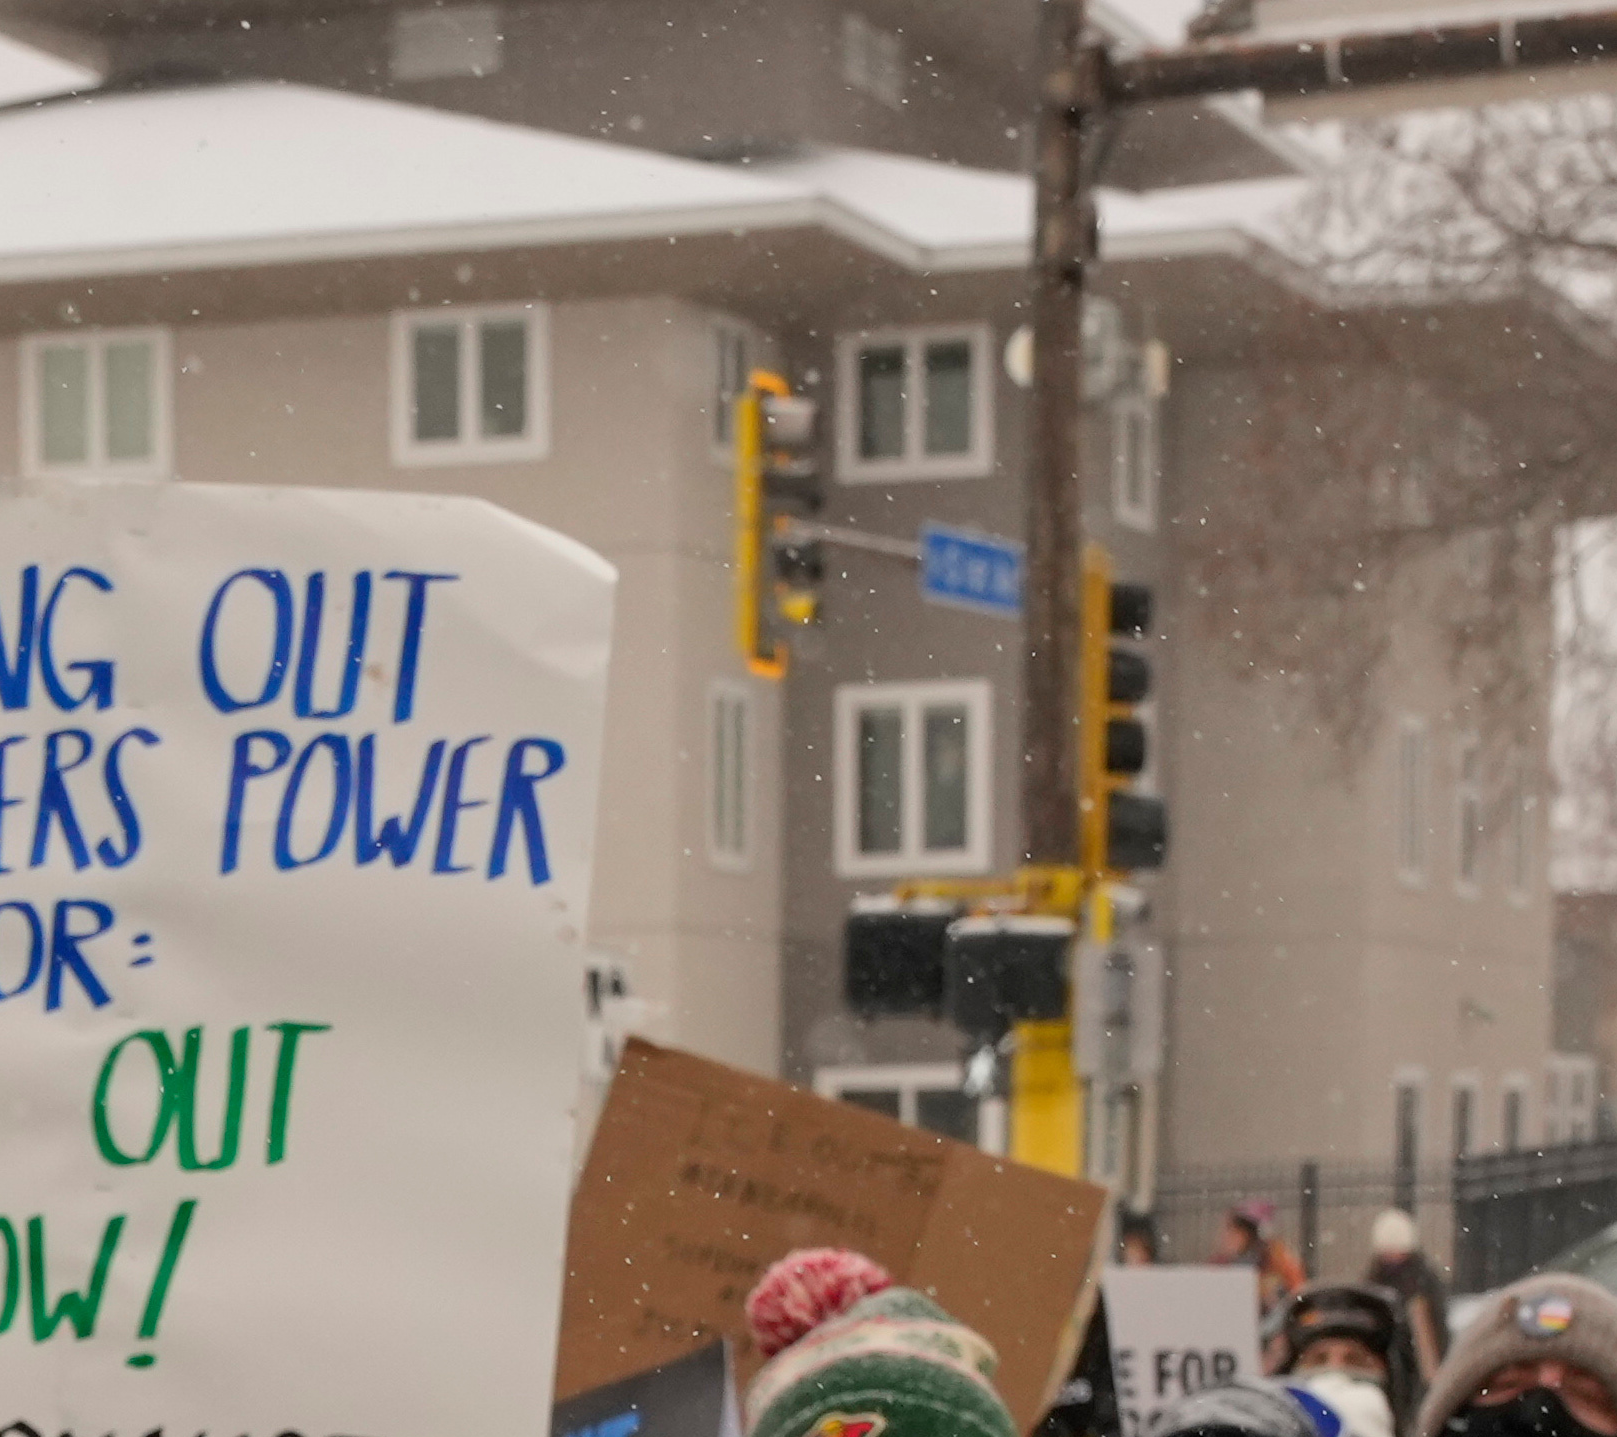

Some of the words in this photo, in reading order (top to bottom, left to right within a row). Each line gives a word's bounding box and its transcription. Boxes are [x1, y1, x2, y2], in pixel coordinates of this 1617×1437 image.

[199, 569, 461, 724] OUT
[219, 732, 566, 886] POWER
[91, 1021, 333, 1171] OUT
